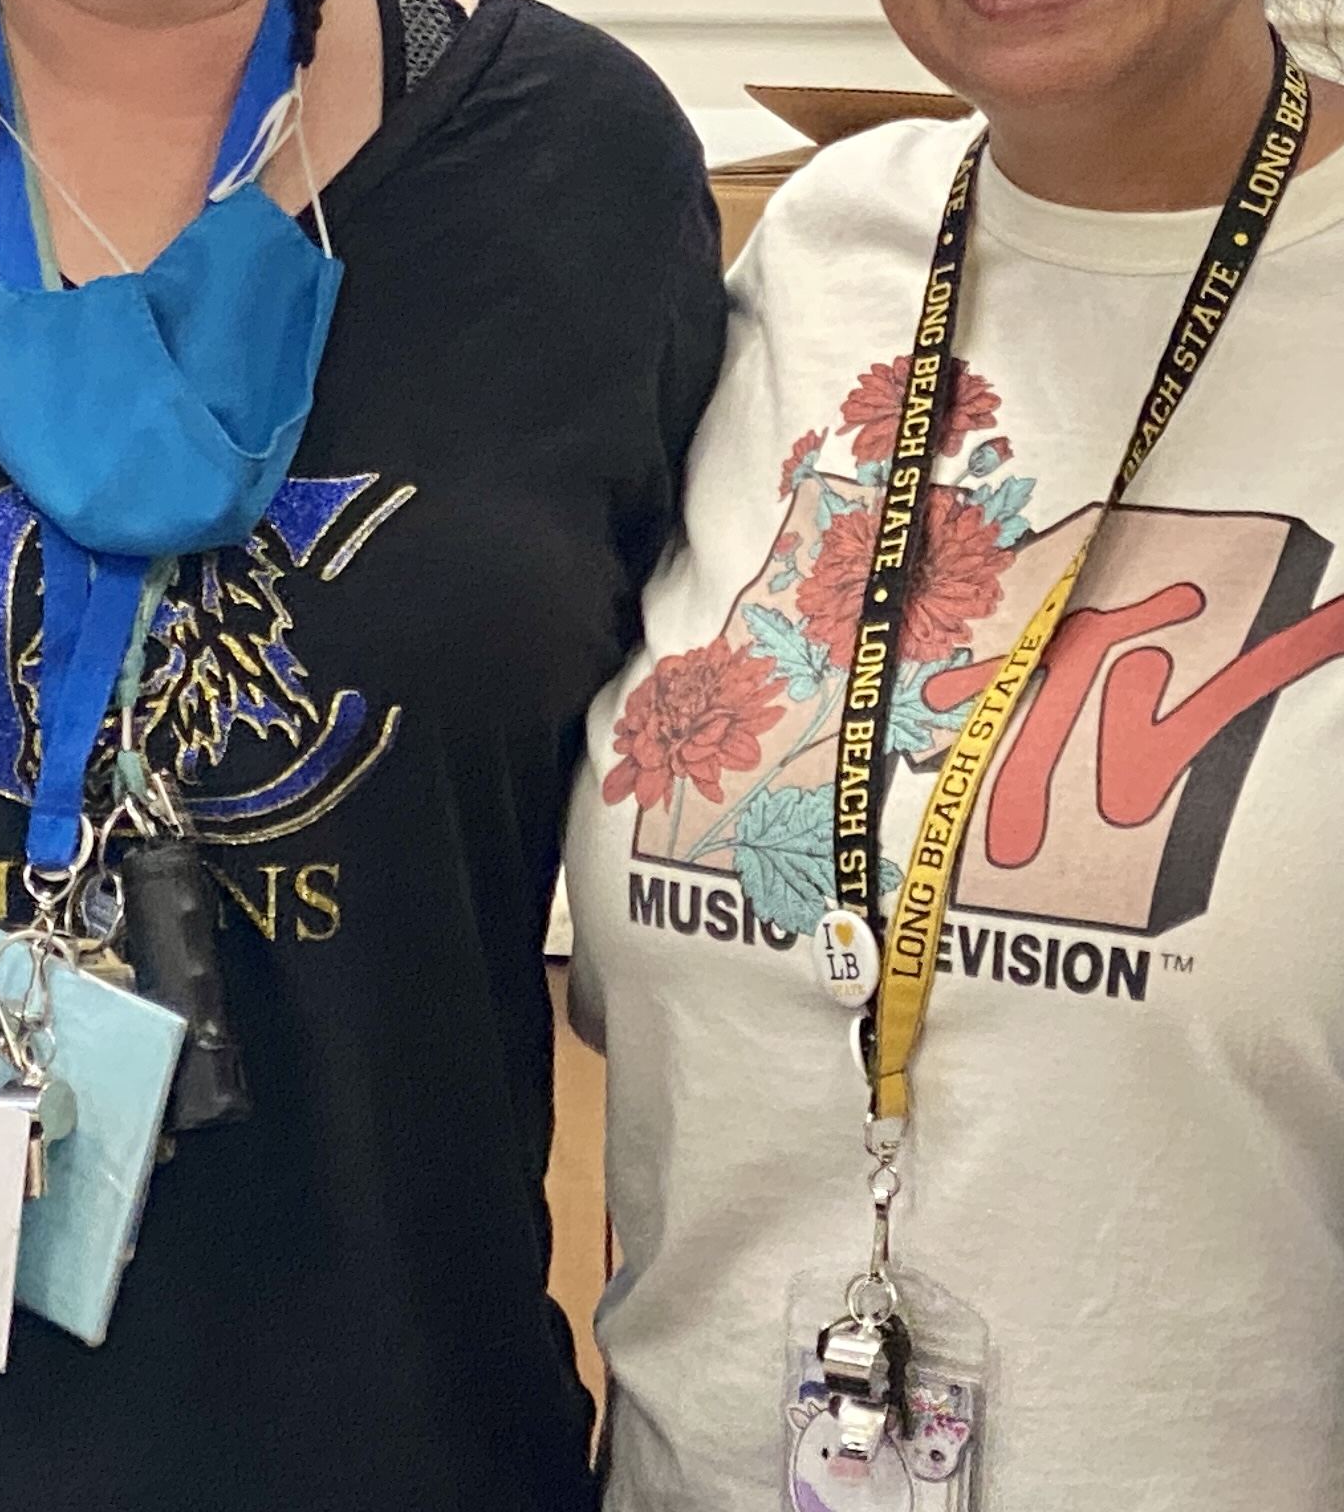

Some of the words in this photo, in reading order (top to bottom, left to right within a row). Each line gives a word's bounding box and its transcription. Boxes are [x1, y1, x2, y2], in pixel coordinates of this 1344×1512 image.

[919, 262, 955, 347] LONG
[1122, 374, 1183, 484] BEACH
[1173, 260, 1240, 373] STATE
[1238, 133, 1296, 216] LONG
[897, 354, 941, 460] BEACH
[875, 466, 921, 571] STATE
[849, 622, 890, 710] LONG
[839, 719, 875, 838] BEACH
[892, 880, 936, 979] LONG
[917, 752, 980, 870] BEACH
[968, 634, 1041, 742] STATE
[839, 849, 868, 918] STA
[822, 923, 834, 950] I
[827, 953, 860, 980] LB
[934, 922, 1151, 1001] EVISION
